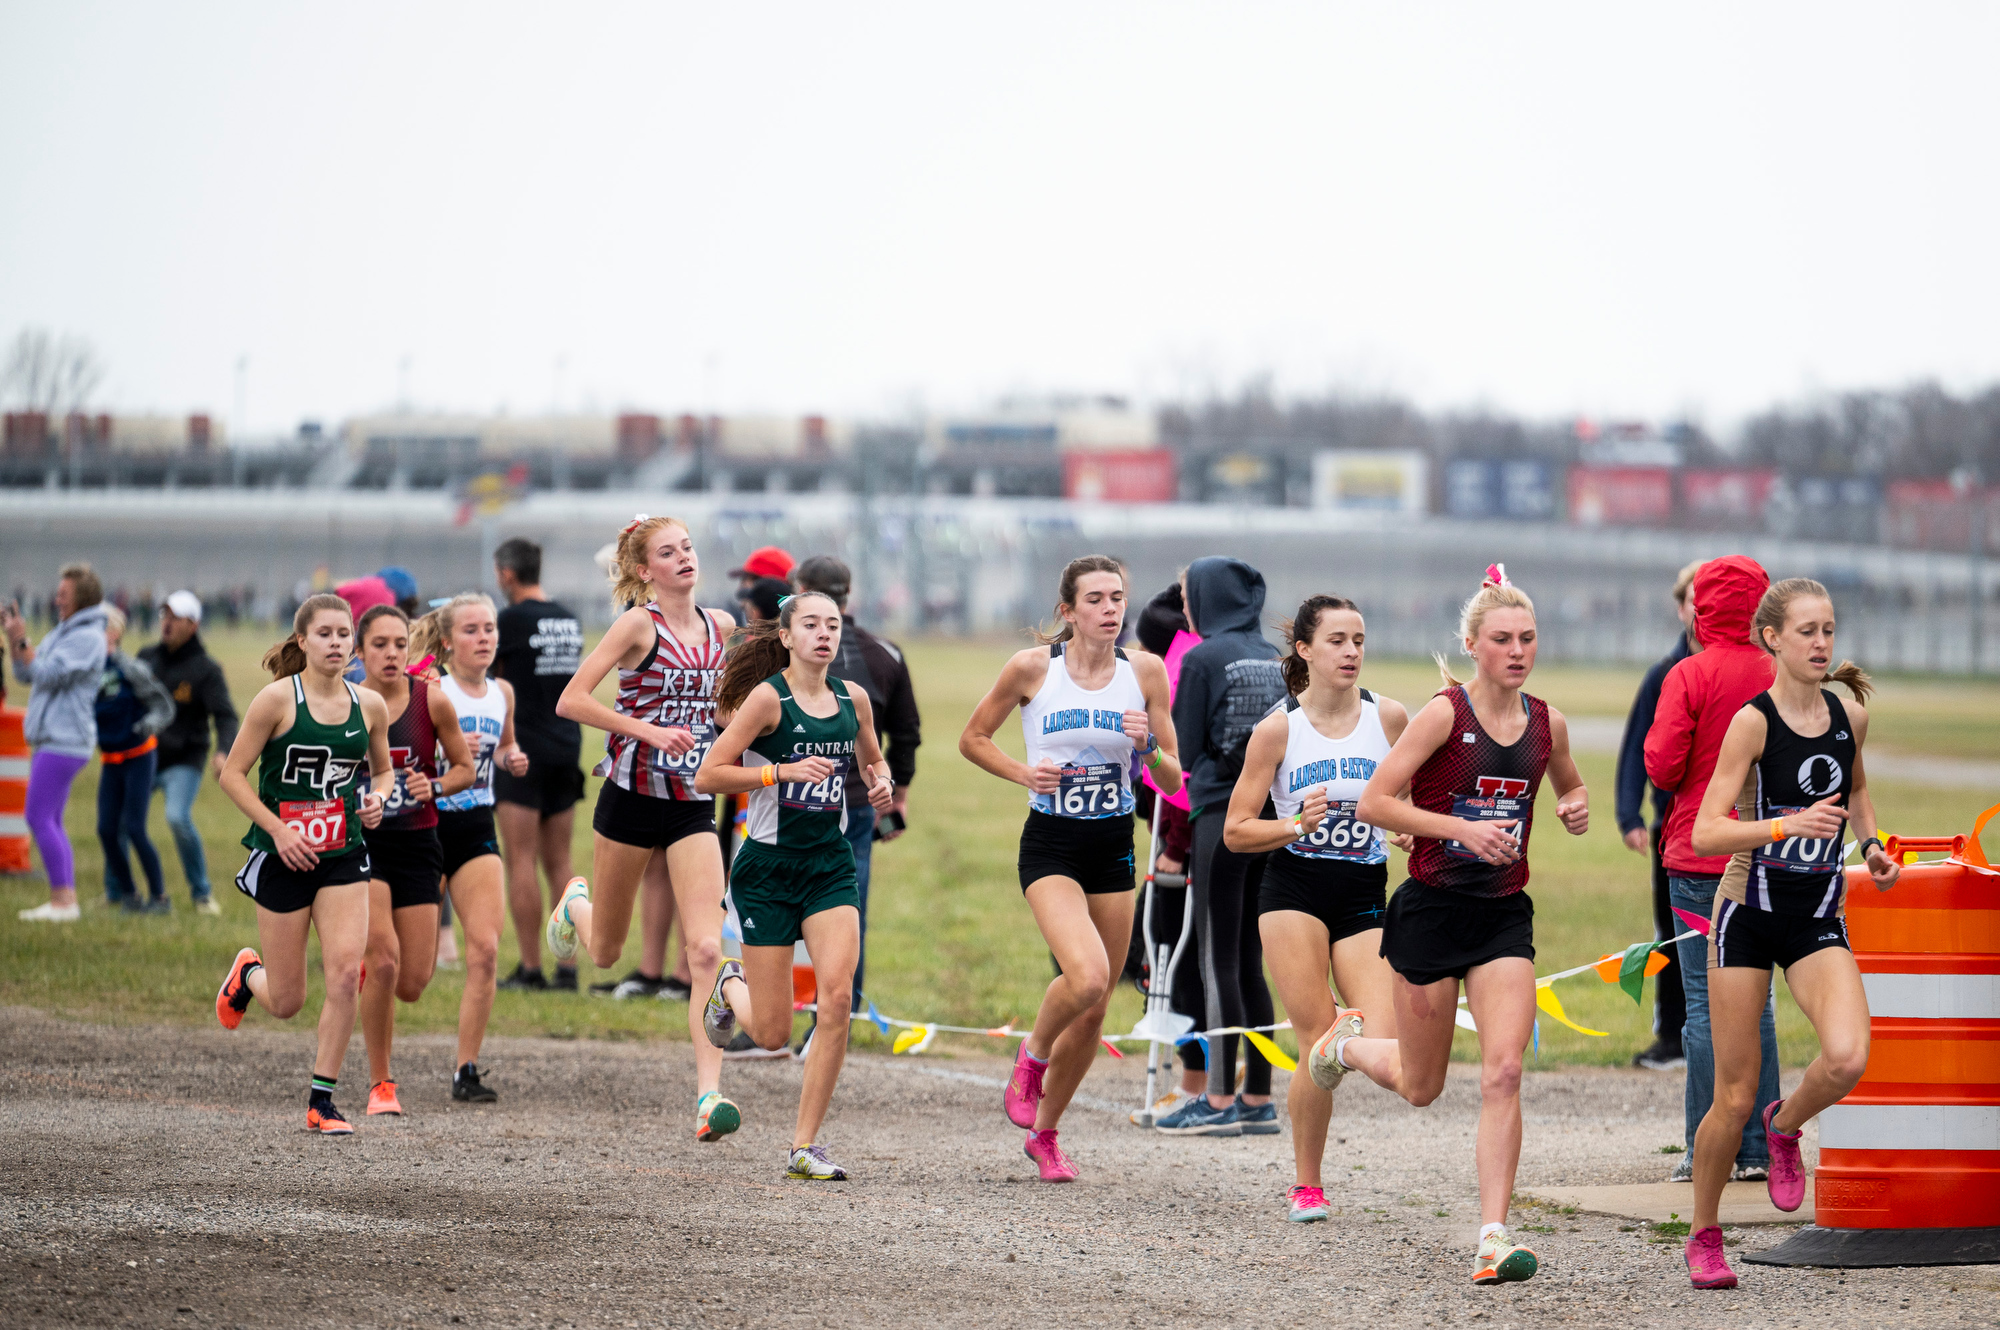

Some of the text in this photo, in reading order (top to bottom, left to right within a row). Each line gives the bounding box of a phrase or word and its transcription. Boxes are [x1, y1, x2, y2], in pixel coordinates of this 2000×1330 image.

[660, 668, 725, 698] KEN
[1042, 709, 1125, 735] LANSING CATH
[793, 741, 855, 756] CENTRAL
[1289, 759, 1337, 794] LANSING
[1797, 753, 1844, 797] O
[1054, 782, 1119, 814] 1673
[1480, 809, 1493, 817] 2022
[1299, 818, 1371, 849] 669
[1841, 1195, 1874, 1207] ONLY
[1854, 1181, 1886, 1193] RING
